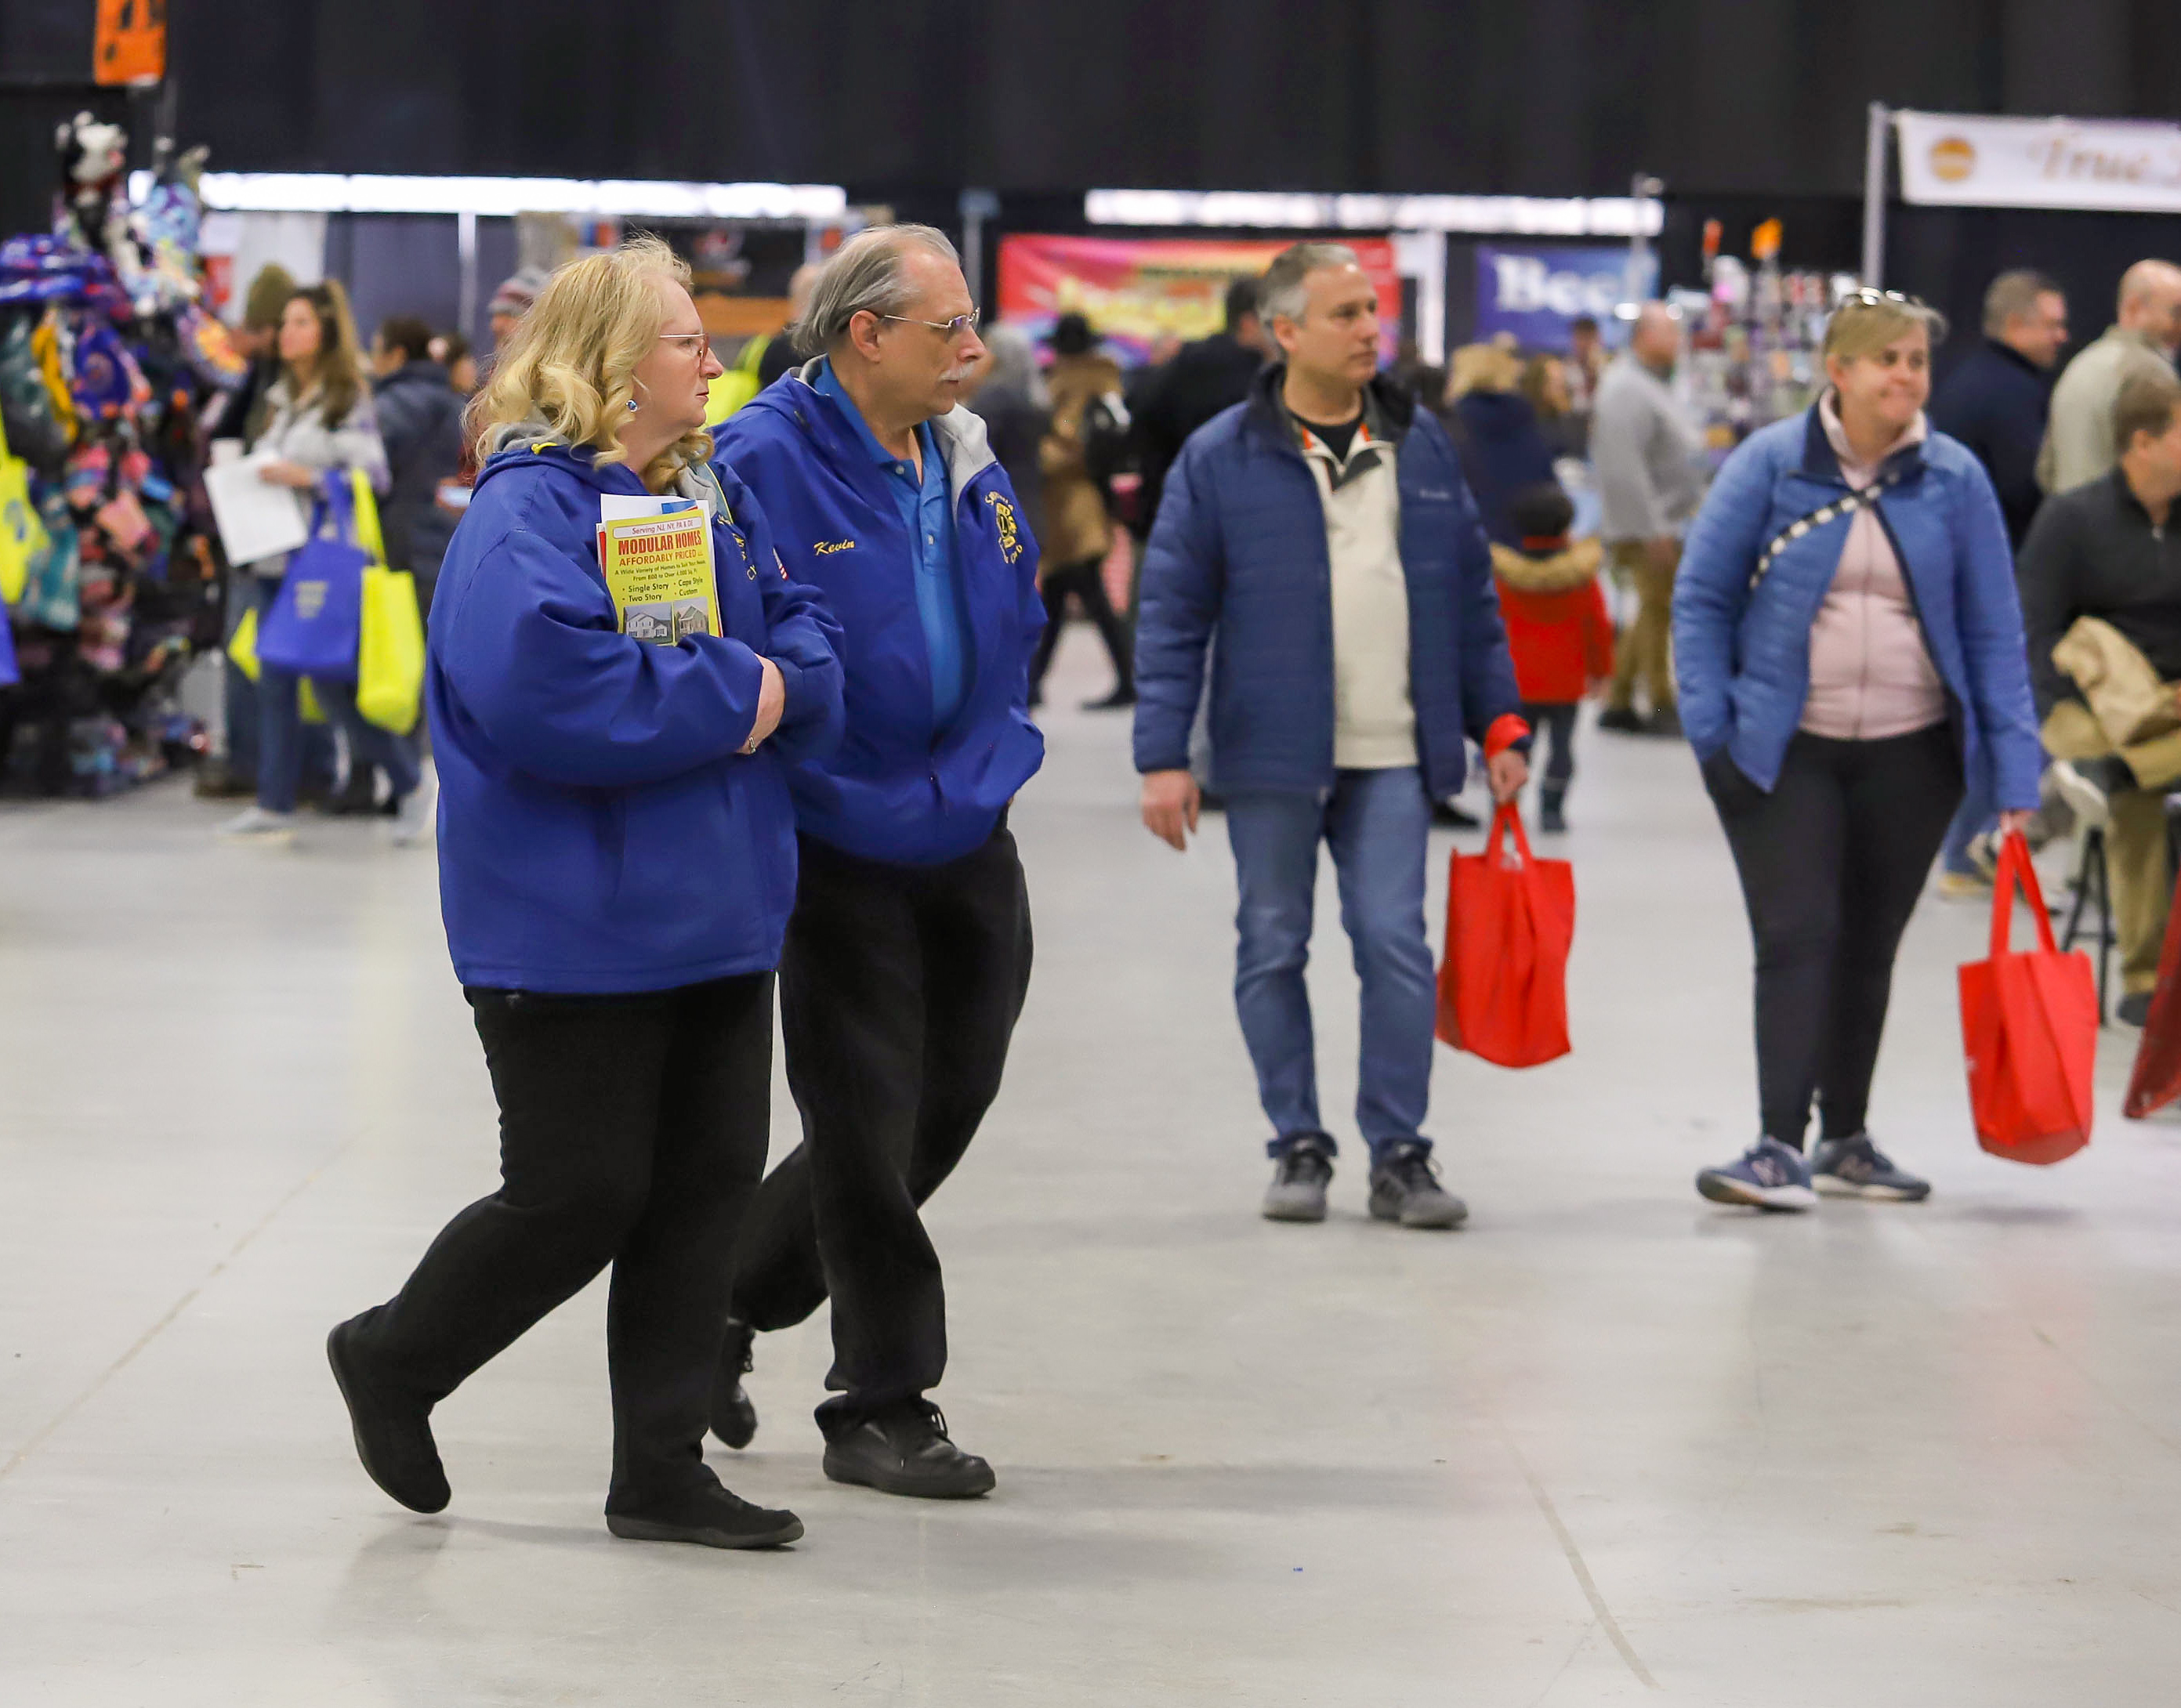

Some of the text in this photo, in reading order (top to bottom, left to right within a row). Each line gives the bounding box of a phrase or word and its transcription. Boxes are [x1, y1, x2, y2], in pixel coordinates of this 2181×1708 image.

[618, 530, 701, 555] MODULAR HOMES
[814, 539, 855, 555] Kevin
[619, 552, 673, 566] AFFORDABLY
[676, 549, 697, 559] PRICED
[629, 584, 650, 593] Single
